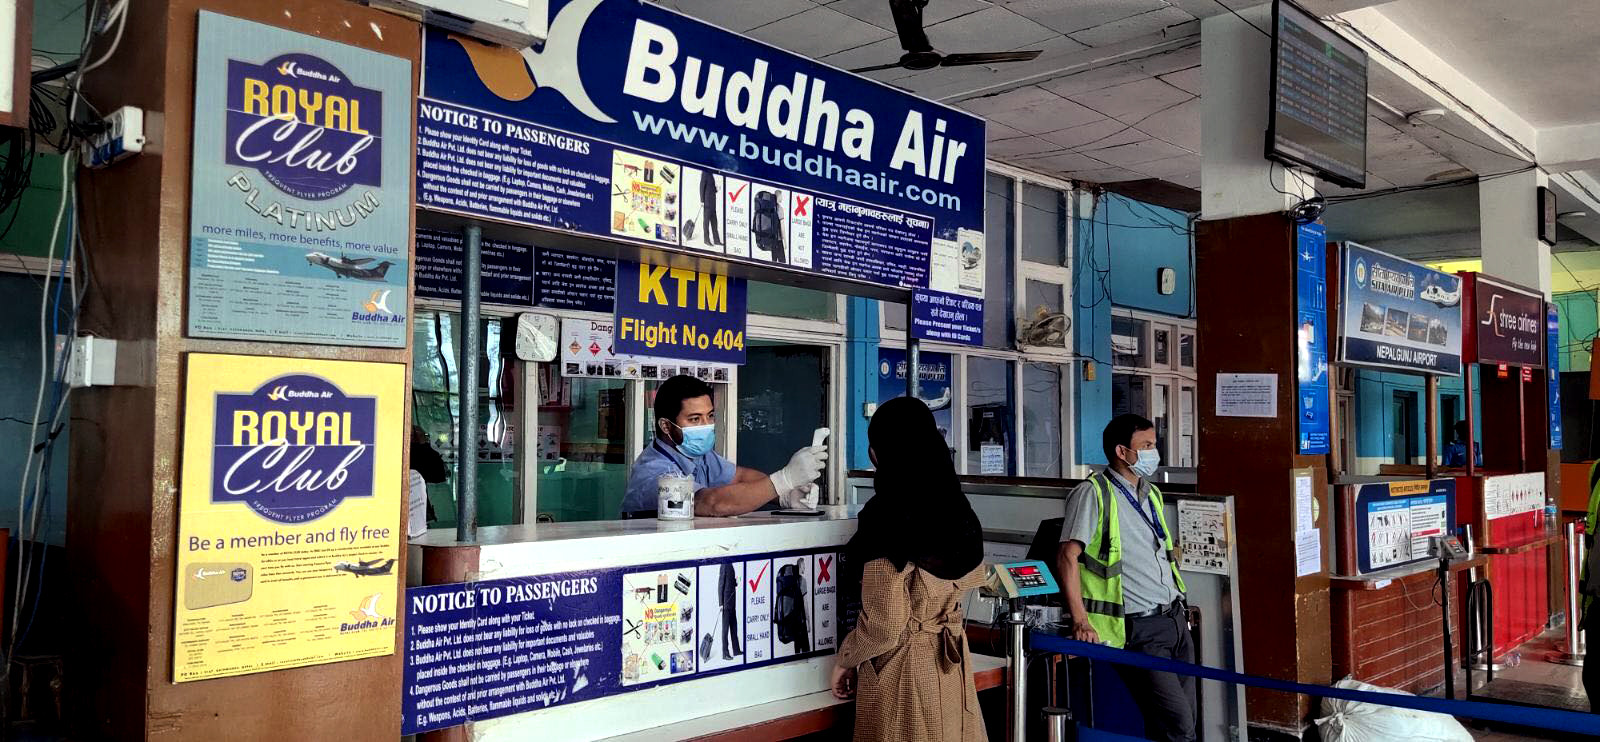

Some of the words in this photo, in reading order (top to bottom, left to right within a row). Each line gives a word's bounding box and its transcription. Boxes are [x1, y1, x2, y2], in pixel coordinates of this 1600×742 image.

[296, 68, 326, 82] Buddha
[328, 74, 340, 84] Air
[244, 78, 368, 135] ROYAL
[623, 18, 874, 162] Buddha
[890, 109, 967, 185] Air
[420, 103, 478, 130] NOTICE
[482, 118, 502, 134] TO
[506, 124, 590, 155] PASSENGERS
[235, 113, 374, 175] Club
[632, 110, 961, 211] www.buddhaair.com
[264, 170, 296, 196] FREQUENT
[296, 190, 316, 199] FLYER
[316, 183, 348, 198] PROGRAM
[226, 171, 380, 232] PLATINUM
[202, 224, 232, 237] more
[235, 224, 267, 242] miles,
[269, 232, 297, 242] more
[300, 234, 342, 249] benefits,
[345, 240, 370, 252] more
[372, 241, 399, 254] value
[639, 262, 728, 312] KTM
[352, 312, 388, 322] Buddha
[390, 314, 406, 324] Air
[914, 318, 932, 326] Please
[932, 320, 951, 329] Present
[1500, 308, 1516, 330] shree
[1518, 312, 1537, 334] airlines
[620, 317, 677, 348] Flight
[682, 324, 709, 350] No
[712, 328, 744, 351] 404
[926, 330, 940, 338] along
[958, 333, 971, 341] Cards
[1376, 345, 1413, 364] NEPALGUNJ
[1413, 350, 1437, 366] AIRPORT
[288, 390, 320, 400] Buddha
[321, 390, 333, 399] Air
[233, 410, 361, 446] ROYAL
[223, 437, 365, 495] Club
[253, 500, 285, 521] FREQUENT
[306, 499, 337, 520] PROGRAM
[189, 536, 210, 552] Be
[214, 540, 225, 550] a
[230, 530, 302, 548] member
[305, 528, 336, 544] and
[339, 526, 358, 545] fly
[361, 526, 390, 540] free
[412, 589, 475, 614] NOTICE
[480, 587, 501, 606] TO
[506, 576, 597, 603] PASSENGERS
[750, 596, 766, 605] PLEASE
[340, 620, 376, 632] Buddha
[378, 618, 395, 628] Air
[417, 623, 434, 634] Please
[434, 621, 447, 632] show
[447, 619, 458, 633] your
[459, 617, 475, 632] Identity
[476, 616, 487, 626] Card
[488, 614, 500, 628] along
[501, 613, 510, 623] with
[511, 611, 521, 624] your
[644, 608, 654, 620] NO
[747, 614, 759, 624] CARRY
[760, 613, 770, 622] ONLY
[416, 637, 434, 649] Buddha
[463, 632, 474, 643] does
[483, 629, 492, 640] bear
[493, 628, 501, 641] any
[502, 626, 517, 640] liability
[525, 624, 534, 634] loss
[534, 623, 539, 633] of
[553, 620, 561, 630] with
[562, 619, 568, 629] no
[583, 615, 599, 626] checked
[599, 614, 603, 624] in
[415, 652, 434, 664] Buddha
[462, 646, 473, 657] does
[474, 645, 482, 656] not
[483, 643, 492, 654] bear
[493, 642, 501, 656] any
[502, 640, 517, 654] liability
[525, 636, 545, 651] important
[546, 633, 567, 645] documents
[576, 629, 594, 640] valuables
[754, 650, 762, 658] BAG
[415, 680, 441, 697] Dangerous
[441, 678, 457, 690] Goods
[457, 676, 469, 687] shall
[478, 673, 484, 684] be
[500, 670, 506, 683] by
[507, 666, 531, 681] passengers
[532, 665, 536, 674] in
[536, 663, 546, 673] their
